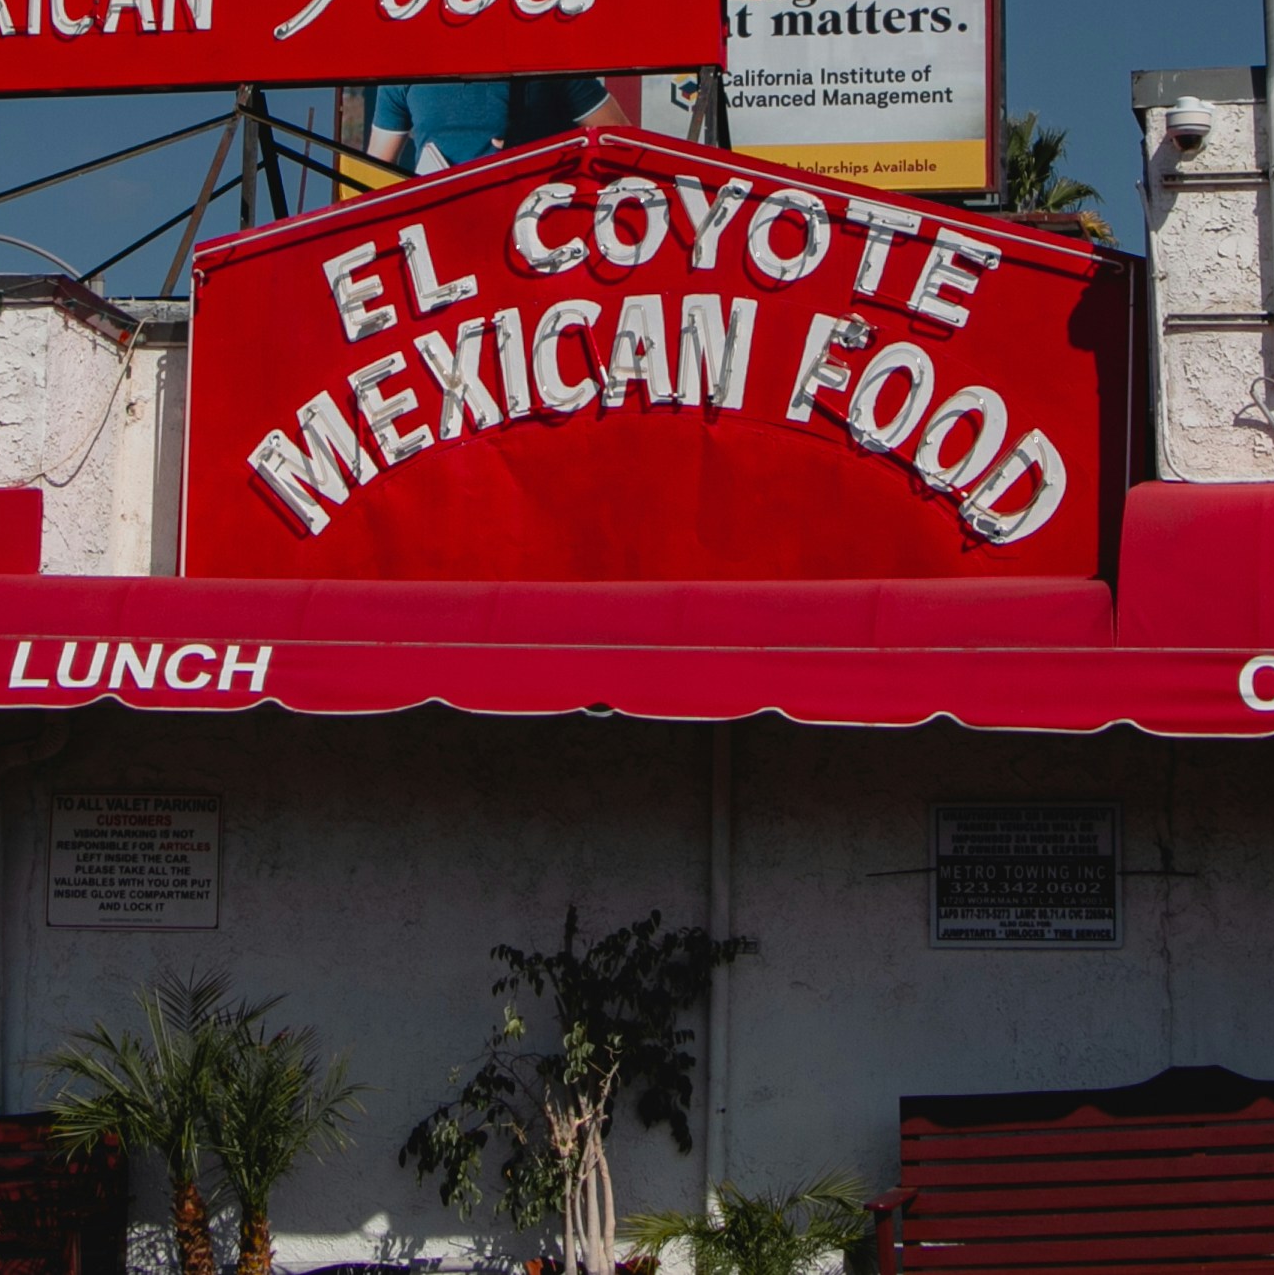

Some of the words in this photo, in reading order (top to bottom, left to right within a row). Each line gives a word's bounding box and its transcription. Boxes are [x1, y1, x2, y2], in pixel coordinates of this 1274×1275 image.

[770, 1, 967, 37] matters.
[722, 68, 813, 87] California
[821, 67, 905, 85] Institute
[911, 65, 931, 82] of
[822, 87, 953, 108] Management
[873, 159, 937, 173] Available
[324, 223, 478, 343] EL
[513, 175, 1002, 329] COYOTE
[247, 293, 757, 537] MEXICAN
[787, 311, 1067, 545] FOOD
[9, 641, 273, 692] LUNCH
[56, 797, 74, 811] TO
[77, 798, 103, 811] ALL
[106, 799, 150, 811] VALET
[154, 799, 217, 813] PARKING
[97, 814, 173, 826] CUSTOMERS
[74, 829, 108, 839] VISION
[111, 829, 157, 839] PARKING
[160, 829, 170, 839] IS
[173, 829, 194, 839] NOT
[56, 841, 129, 851] RESPONSIBLE
[132, 842, 155, 851] FOR
[159, 842, 211, 852] ARTICLES
[77, 853, 102, 862] LEFT
[105, 854, 139, 863] INSIDE
[142, 854, 162, 864] THE
[165, 854, 190, 864] CAR.
[75, 865, 116, 875] PLEASE
[118, 865, 145, 875] TAKE
[148, 866, 168, 875] ALL
[171, 866, 191, 876] THE
[940, 864, 996, 879] METRO
[1003, 864, 1070, 879] TOWING
[54, 877, 115, 887] VALUABLES
[118, 877, 145, 887] WITH
[148, 878, 169, 887] YOU
[172, 878, 188, 887] OR
[191, 878, 212, 888] PUT
[950, 881, 1102, 894] 323.342.0602
[53, 889, 87, 899] INSIDE
[90, 889, 126, 899] GLOVE
[129, 889, 211, 900] COMPARTMENT
[968, 896, 1019, 905] WORKMAN
[99, 902, 121, 912] AND
[123, 902, 153, 913] LOCK
[155, 902, 166, 913] IT
